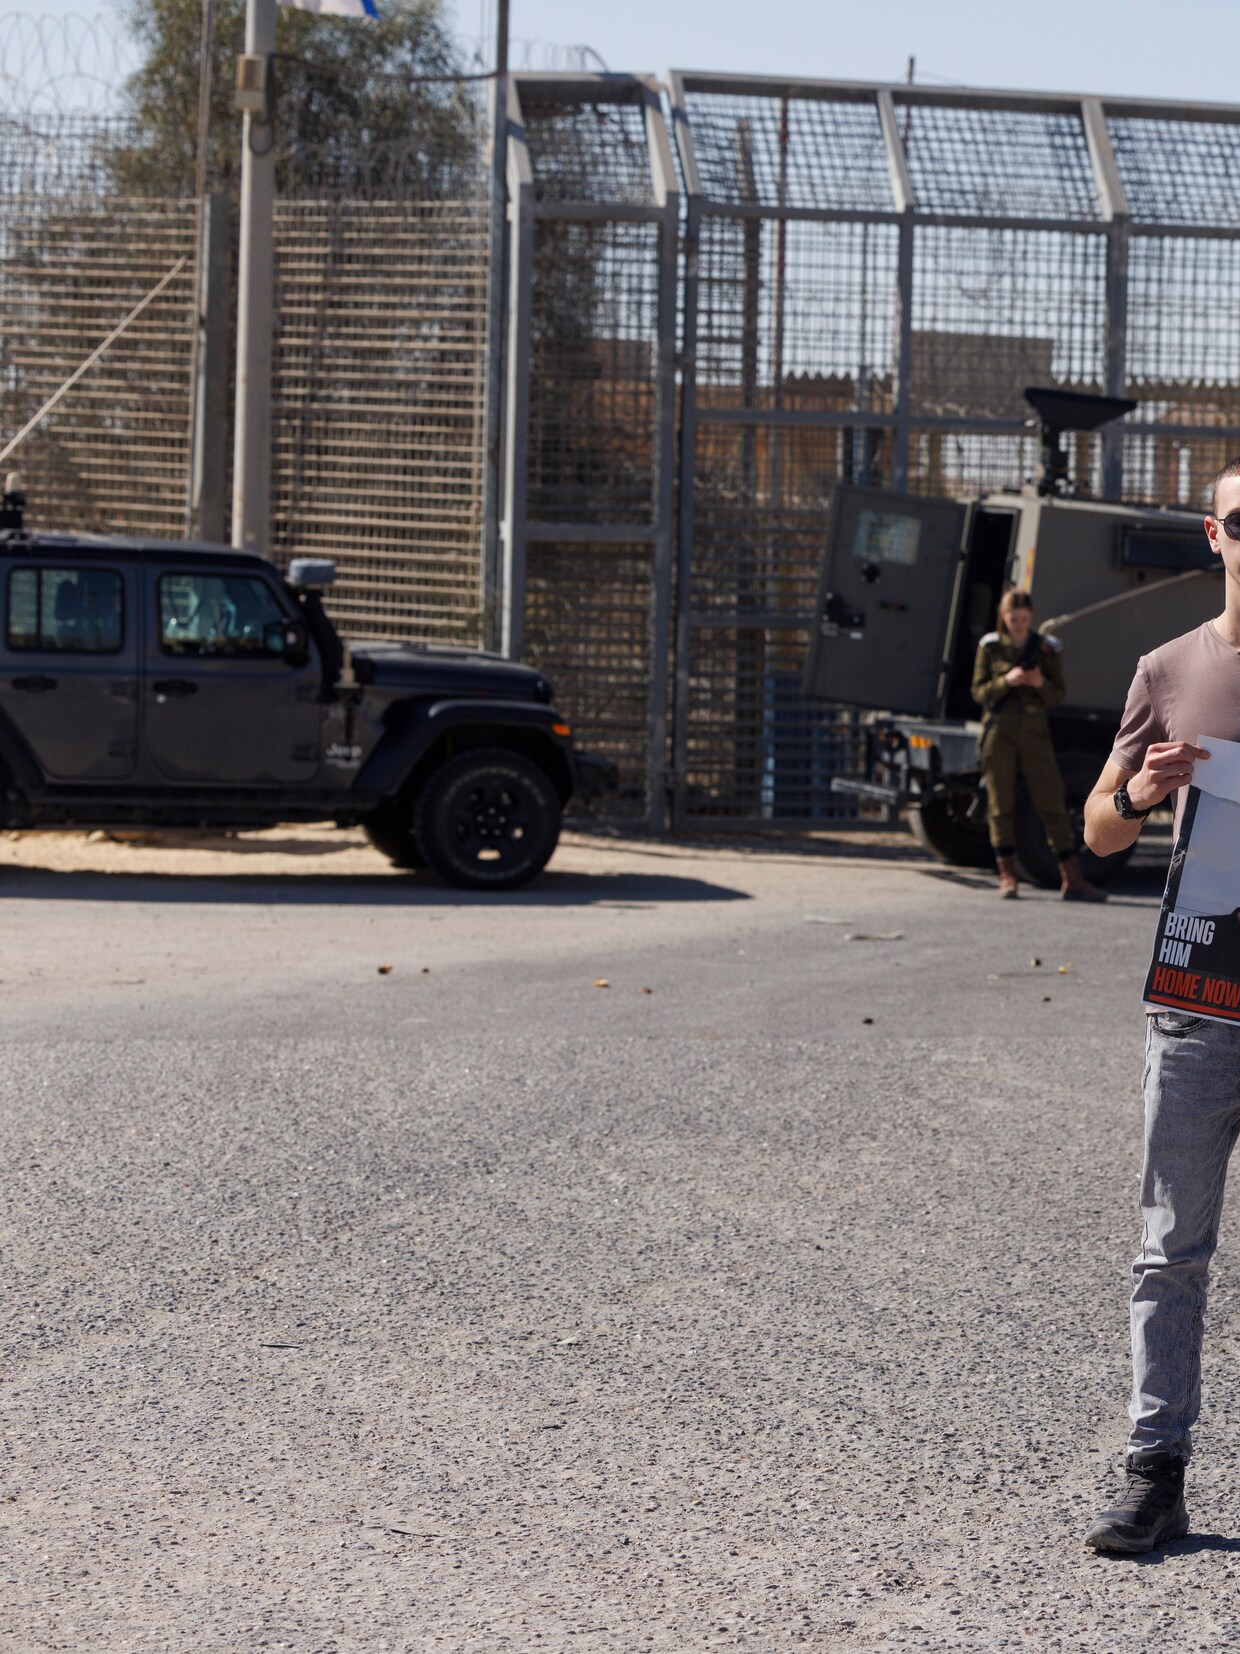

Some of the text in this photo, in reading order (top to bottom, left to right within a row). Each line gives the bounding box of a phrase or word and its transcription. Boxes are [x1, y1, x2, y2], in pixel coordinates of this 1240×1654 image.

[1164, 912, 1216, 945] BRING
[1158, 938, 1192, 968] HIM
[1152, 966, 1201, 1000] HOME
